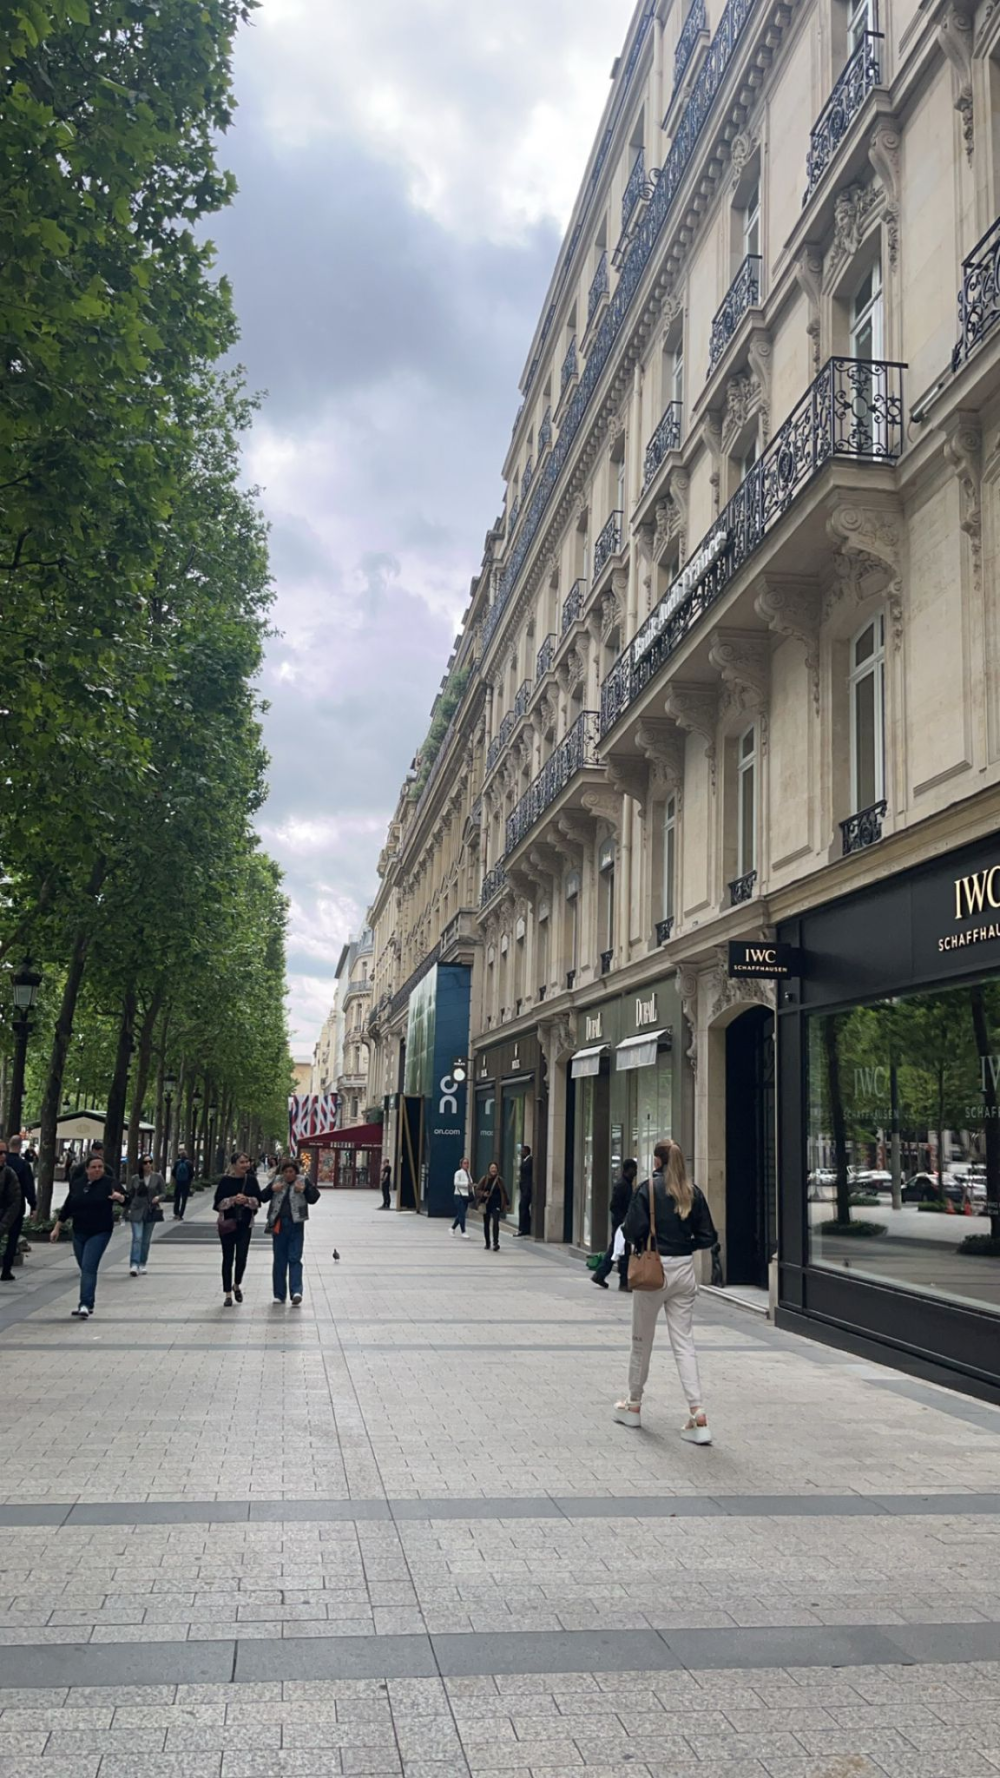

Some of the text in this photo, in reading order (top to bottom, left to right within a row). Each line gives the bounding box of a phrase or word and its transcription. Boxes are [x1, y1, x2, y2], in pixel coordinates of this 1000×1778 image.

[954, 865, 1000, 919] IWC
[745, 948, 776, 963] IWC
[733, 965, 788, 973] SCHAFFHAUSEN
[854, 1066, 884, 1099] IWC
